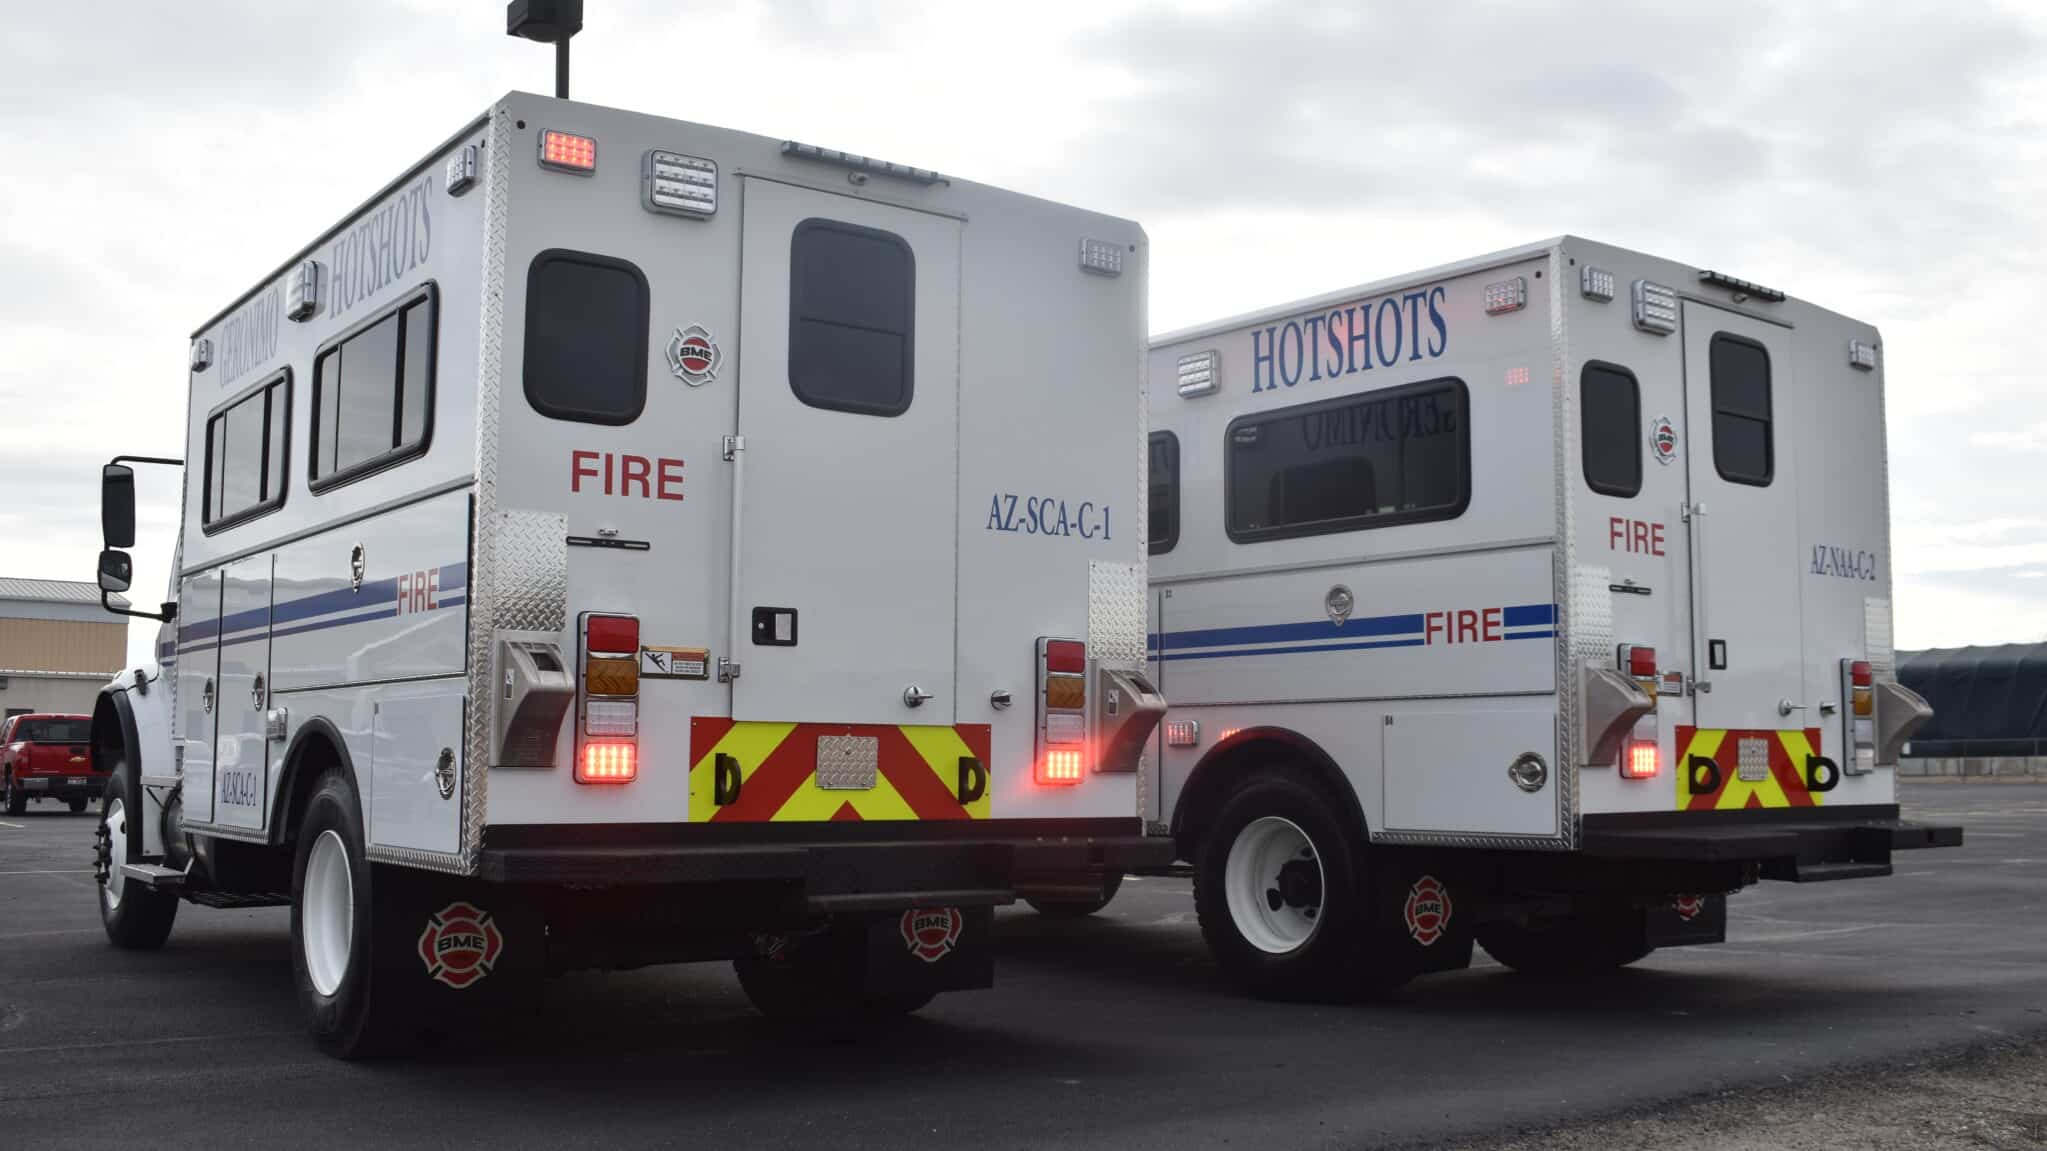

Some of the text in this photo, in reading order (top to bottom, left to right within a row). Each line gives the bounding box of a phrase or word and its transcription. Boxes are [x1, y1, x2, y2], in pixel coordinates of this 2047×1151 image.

[329, 176, 433, 319] HOTSHOTS
[680, 346, 713, 362] BME
[1251, 287, 1447, 393] HOTSHOTS
[571, 450, 685, 501] FIRE
[986, 493, 1112, 540] AZ-SCA-C-1
[1609, 516, 1665, 557] FIRE
[398, 568, 438, 616] FIRE
[1426, 607, 1502, 645] FIRE
[438, 935, 484, 952] BME
[914, 916, 949, 930] BME
